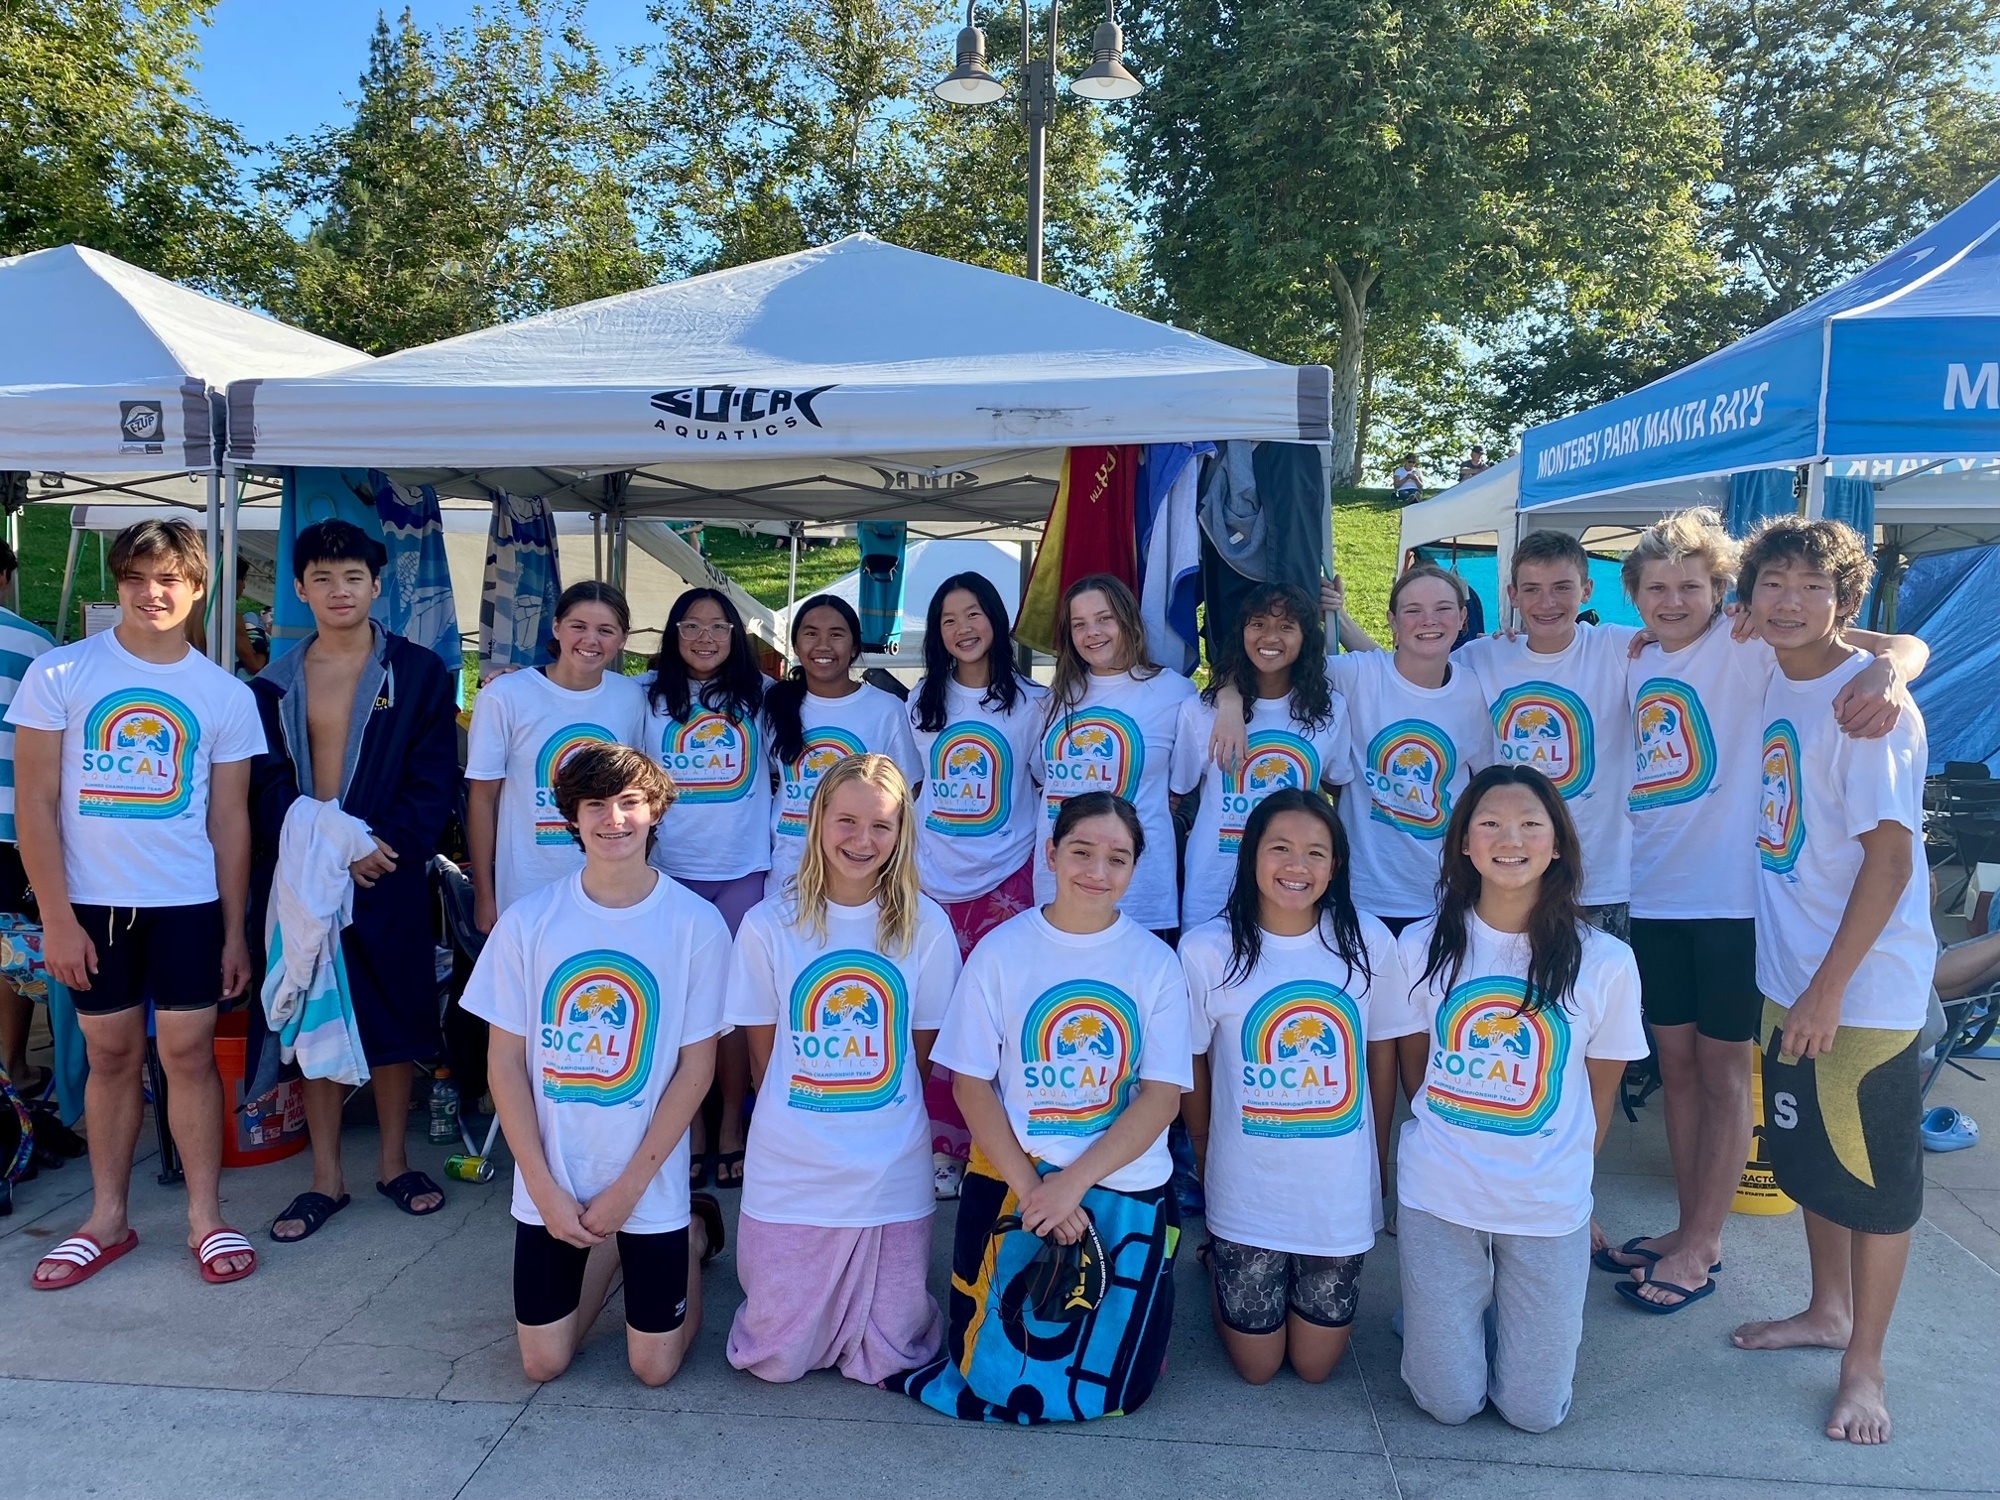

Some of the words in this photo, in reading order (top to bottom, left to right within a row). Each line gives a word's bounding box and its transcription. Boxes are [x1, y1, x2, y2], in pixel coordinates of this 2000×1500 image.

[654, 416, 798, 441] AQUATICS
[1537, 430, 1602, 480] MONTEREY
[1602, 416, 1642, 461] PARK
[1643, 399, 1707, 450] MANTA
[1709, 382, 1769, 435] RAYS
[662, 754, 735, 769] SOCAL
[1500, 744, 1562, 762] OCAL
[82, 753, 168, 777] SOCAL
[1048, 764, 1112, 781] SOCAL
[81, 773, 168, 785] AQUATICS
[1053, 780, 1111, 789] QUATICS
[932, 782, 986, 799] SOCAL
[83, 796, 114, 806] 2023
[542, 1028, 620, 1056] SOCAL
[792, 1036, 878, 1058] SOCAL
[795, 1058, 878, 1068] AQUATICS
[1433, 1051, 1526, 1086] SOCAL
[1024, 1066, 1107, 1088] SOCAL
[1243, 1065, 1338, 1089] SOCAL
[1431, 1068, 1524, 1096] AQUATICS
[1434, 1080, 1456, 1091] SUMMER
[794, 1084, 823, 1098] 2023
[1026, 1087, 1106, 1098] AQUATICS
[1243, 1087, 1338, 1098] AQUATICS
[444, 1101, 457, 1115] G
[1430, 1095, 1461, 1112] 2023
[1774, 1091, 1799, 1130] S
[1035, 1116, 1069, 1124] 2023
[1247, 1115, 1282, 1125] 2023
[1740, 1173, 1776, 1183] RACTO
[1092, 1236, 1104, 1260] SUMMER
[1099, 1261, 1107, 1298] CHAMPIONSHIP
